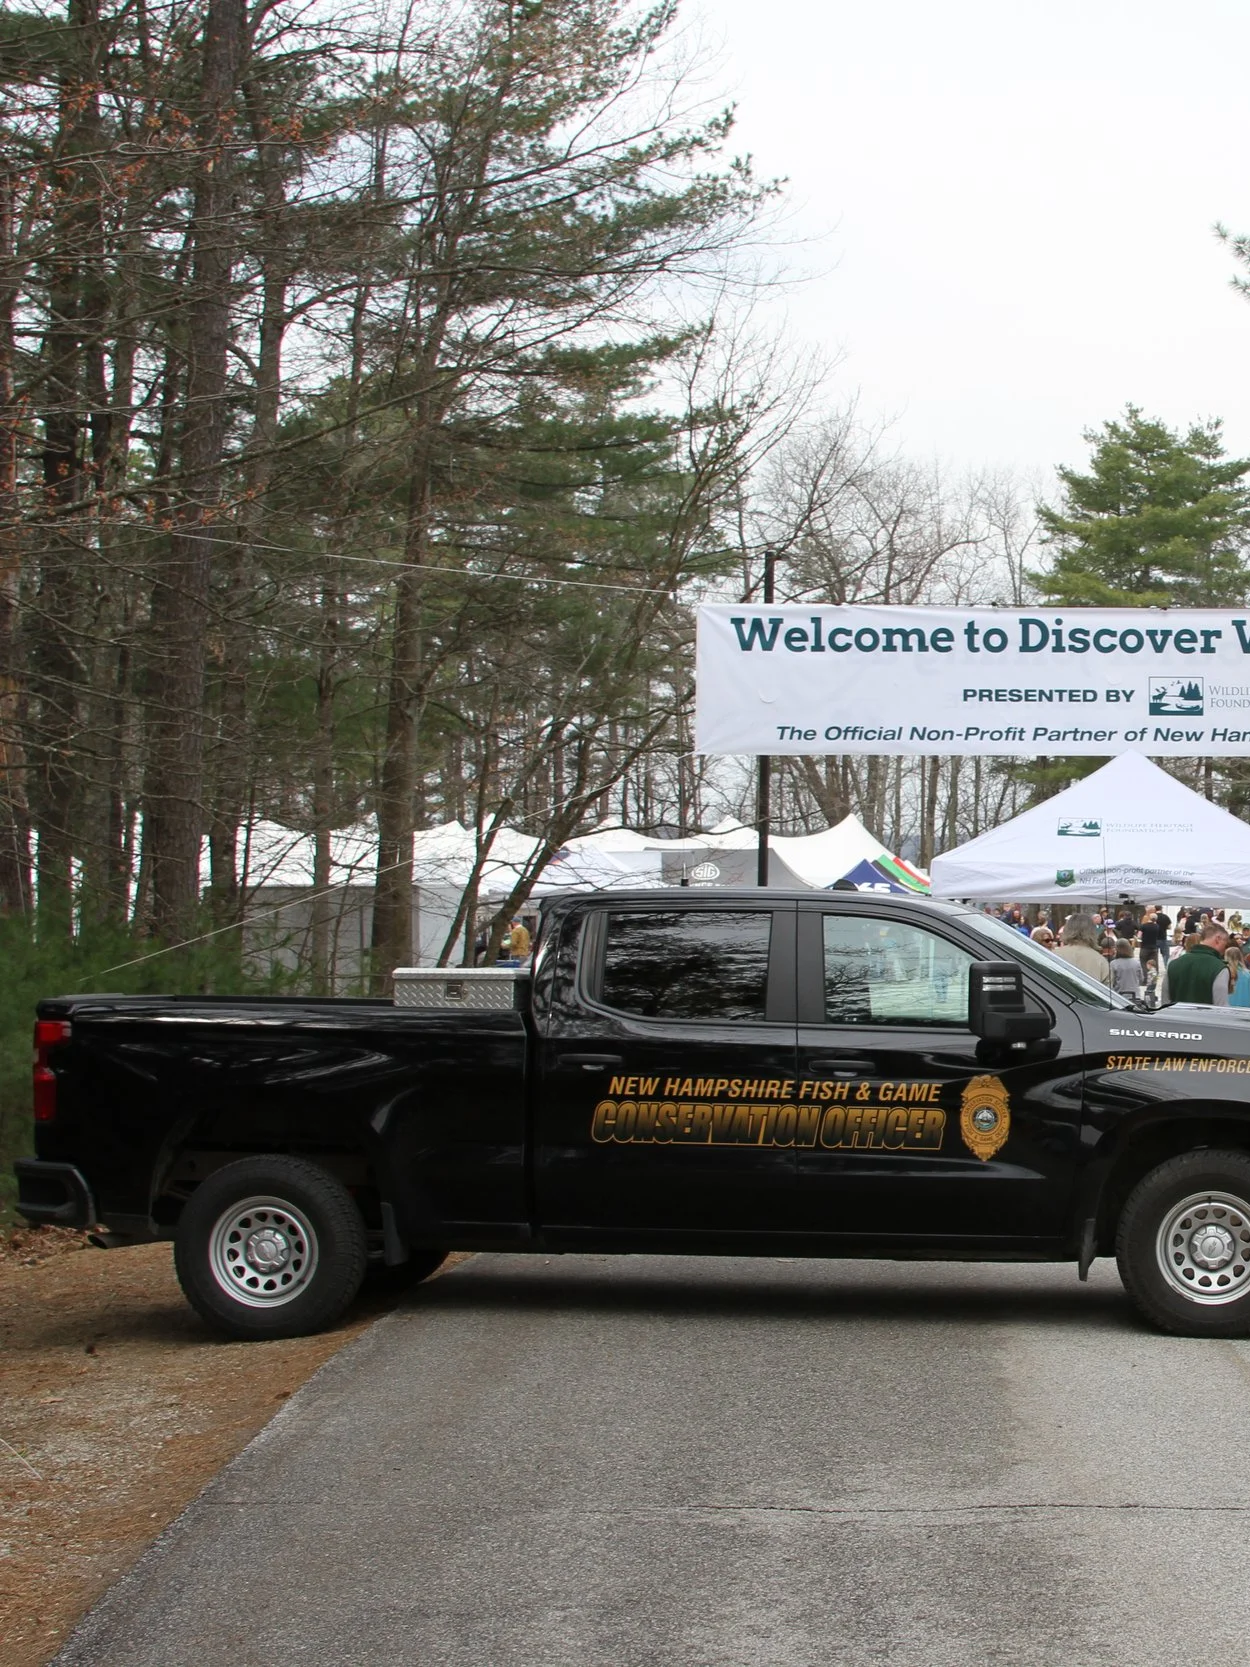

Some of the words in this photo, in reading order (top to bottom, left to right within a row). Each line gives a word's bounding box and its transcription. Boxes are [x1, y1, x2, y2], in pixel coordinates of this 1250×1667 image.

[730, 617, 955, 653] Welcome
[964, 620, 1008, 653] to
[1019, 618, 1222, 655] Discover
[963, 689, 1098, 702] PRESENTED
[1106, 689, 1135, 702] BY
[776, 726, 817, 741] The
[824, 726, 901, 741] Official
[909, 726, 1025, 742] Non-Profit
[1032, 727, 1117, 742] Partner
[1124, 728, 1147, 742] of
[1153, 728, 1203, 743] New
[696, 865, 716, 878] SIG
[1124, 878, 1145, 886] Game
[1149, 878, 1192, 886] Department
[1109, 1028, 1203, 1041] SILVERADO
[1107, 1056, 1151, 1071] STATE
[1153, 1057, 1186, 1072] LAW
[609, 1077, 659, 1096] NEW
[663, 1077, 795, 1099] HAMPSHIRE
[800, 1080, 852, 1100] FISH
[856, 1082, 872, 1100] &
[878, 1082, 943, 1102] GAME
[592, 1100, 820, 1147] CONSERVATION
[820, 1105, 946, 1150] OFFICER
